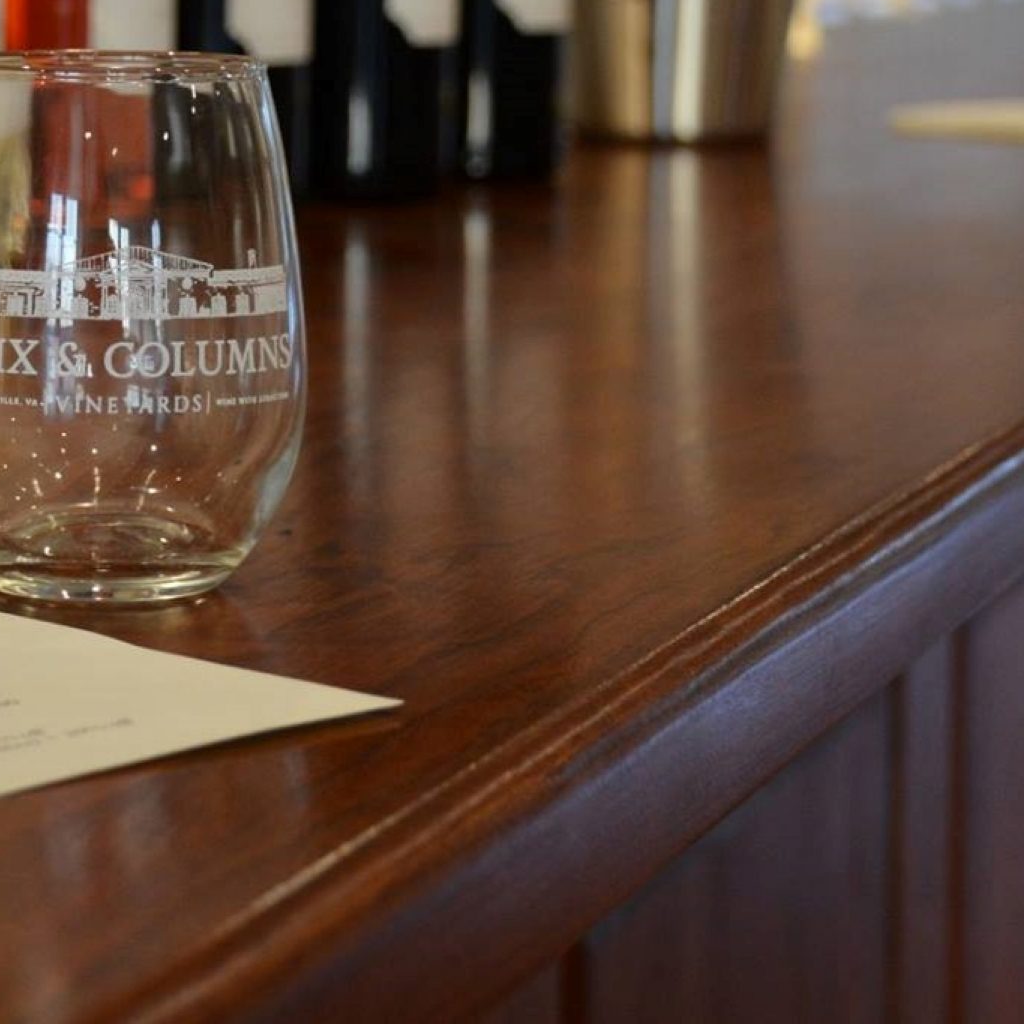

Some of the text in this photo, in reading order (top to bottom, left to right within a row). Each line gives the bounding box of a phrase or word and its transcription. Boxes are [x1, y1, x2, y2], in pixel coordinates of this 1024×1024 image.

[58, 342, 83, 377] &
[104, 332, 293, 379] COLUMNS
[56, 392, 203, 415] VINEYARDS
